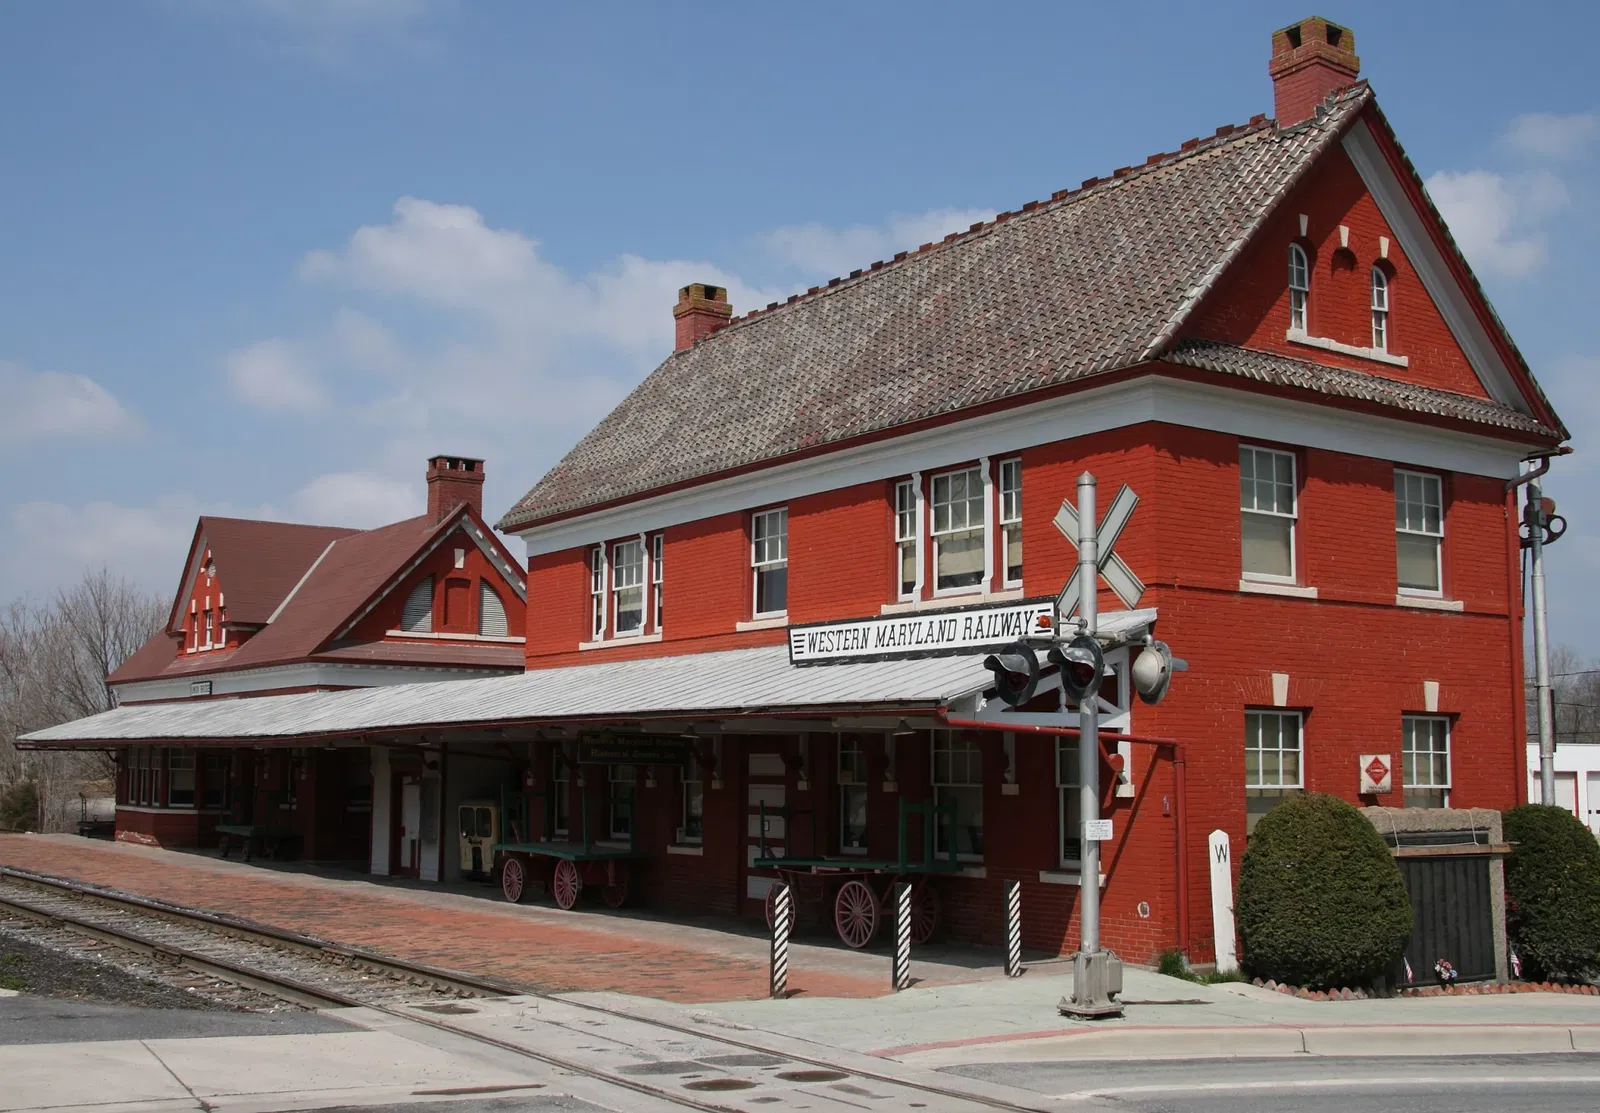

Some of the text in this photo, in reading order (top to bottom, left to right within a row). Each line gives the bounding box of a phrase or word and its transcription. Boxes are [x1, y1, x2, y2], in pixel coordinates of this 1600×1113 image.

[807, 610, 1034, 654] WESTERN MARYLAND RAILWAY
[1214, 844, 1227, 863] W
